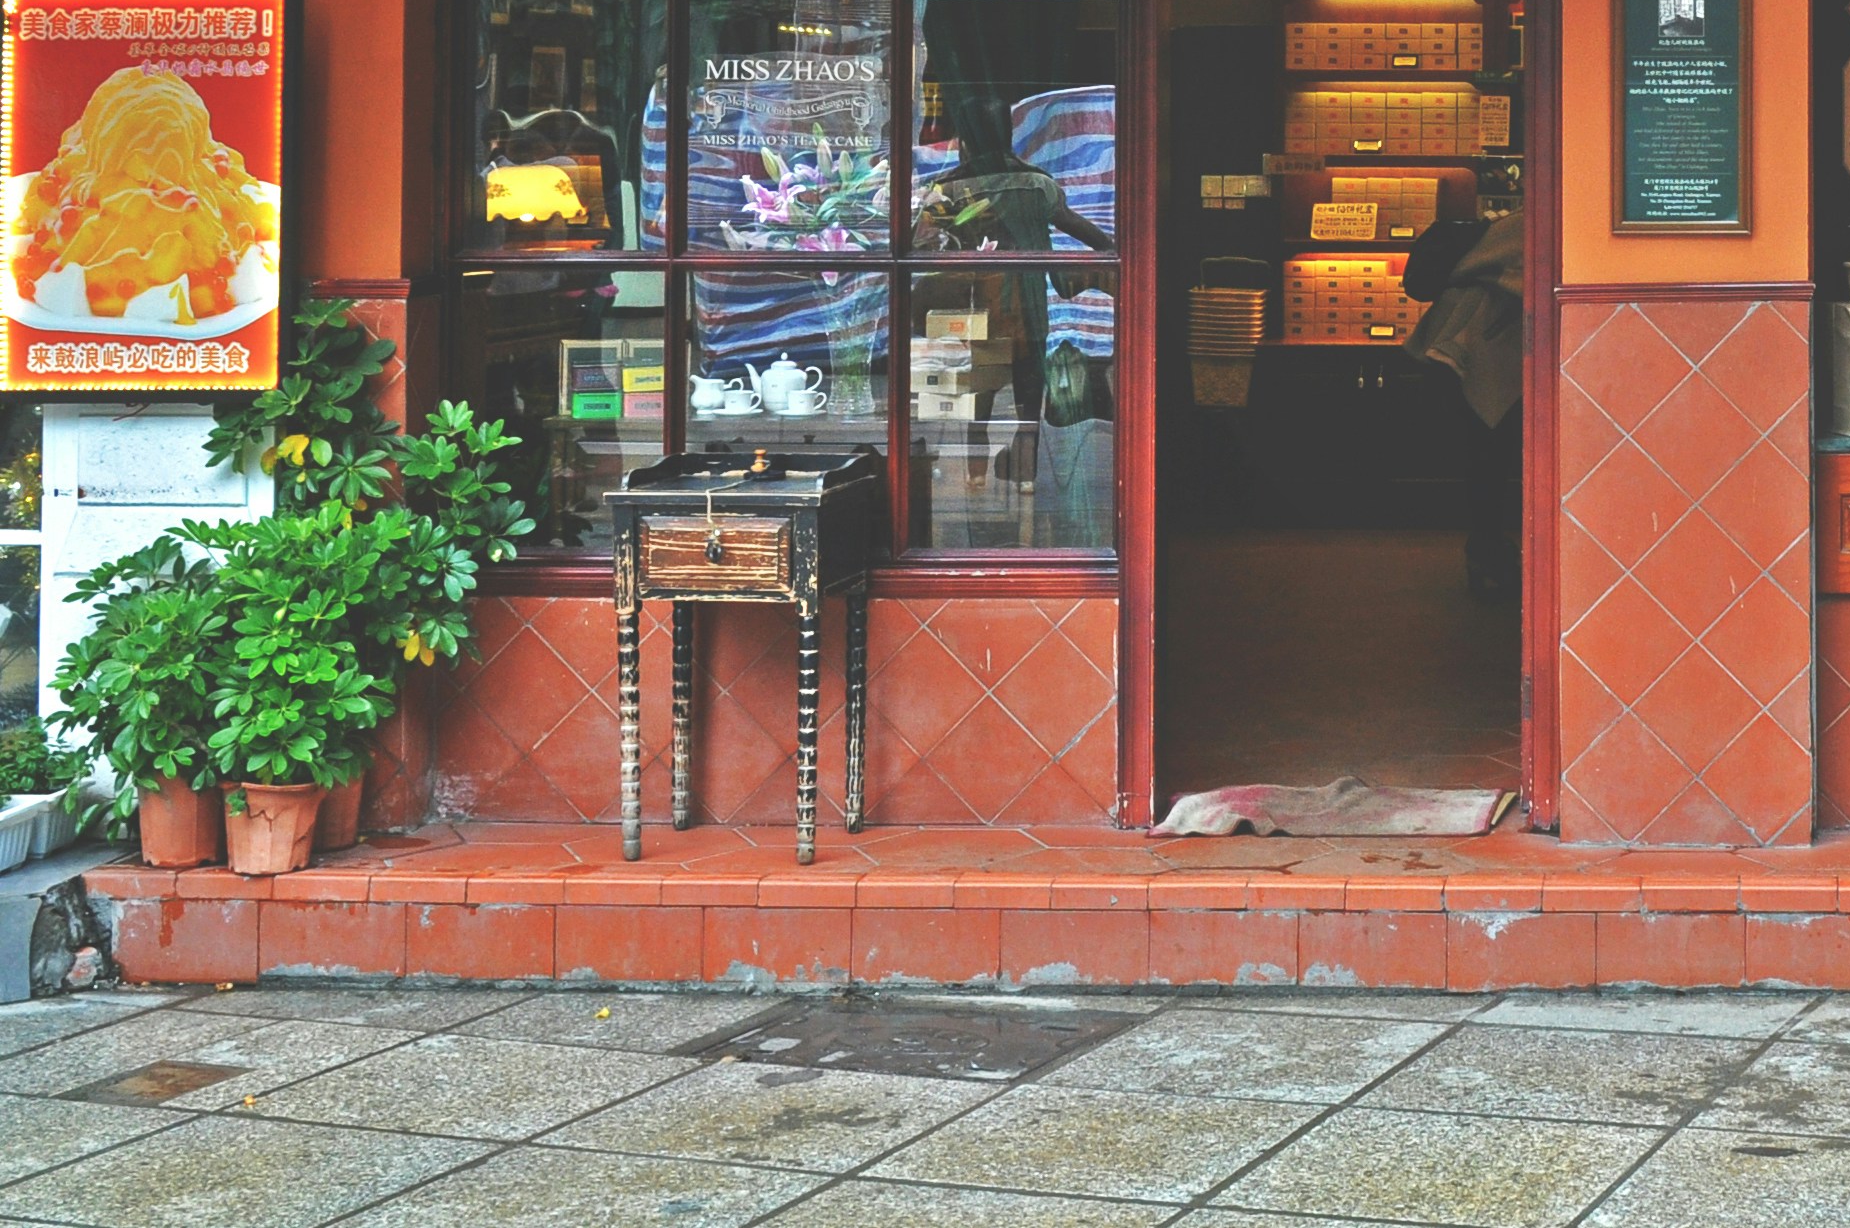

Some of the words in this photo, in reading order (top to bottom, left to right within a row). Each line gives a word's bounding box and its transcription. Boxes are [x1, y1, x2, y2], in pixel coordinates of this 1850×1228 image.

[705, 59, 769, 80] MISS
[775, 59, 875, 81] ZHAO'S
[703, 135, 735, 145] MISS
[792, 136, 818, 146] TEA
[835, 136, 873, 147] CAKE
[29, 342, 249, 373] 来鼓浪屿必吃的美食
